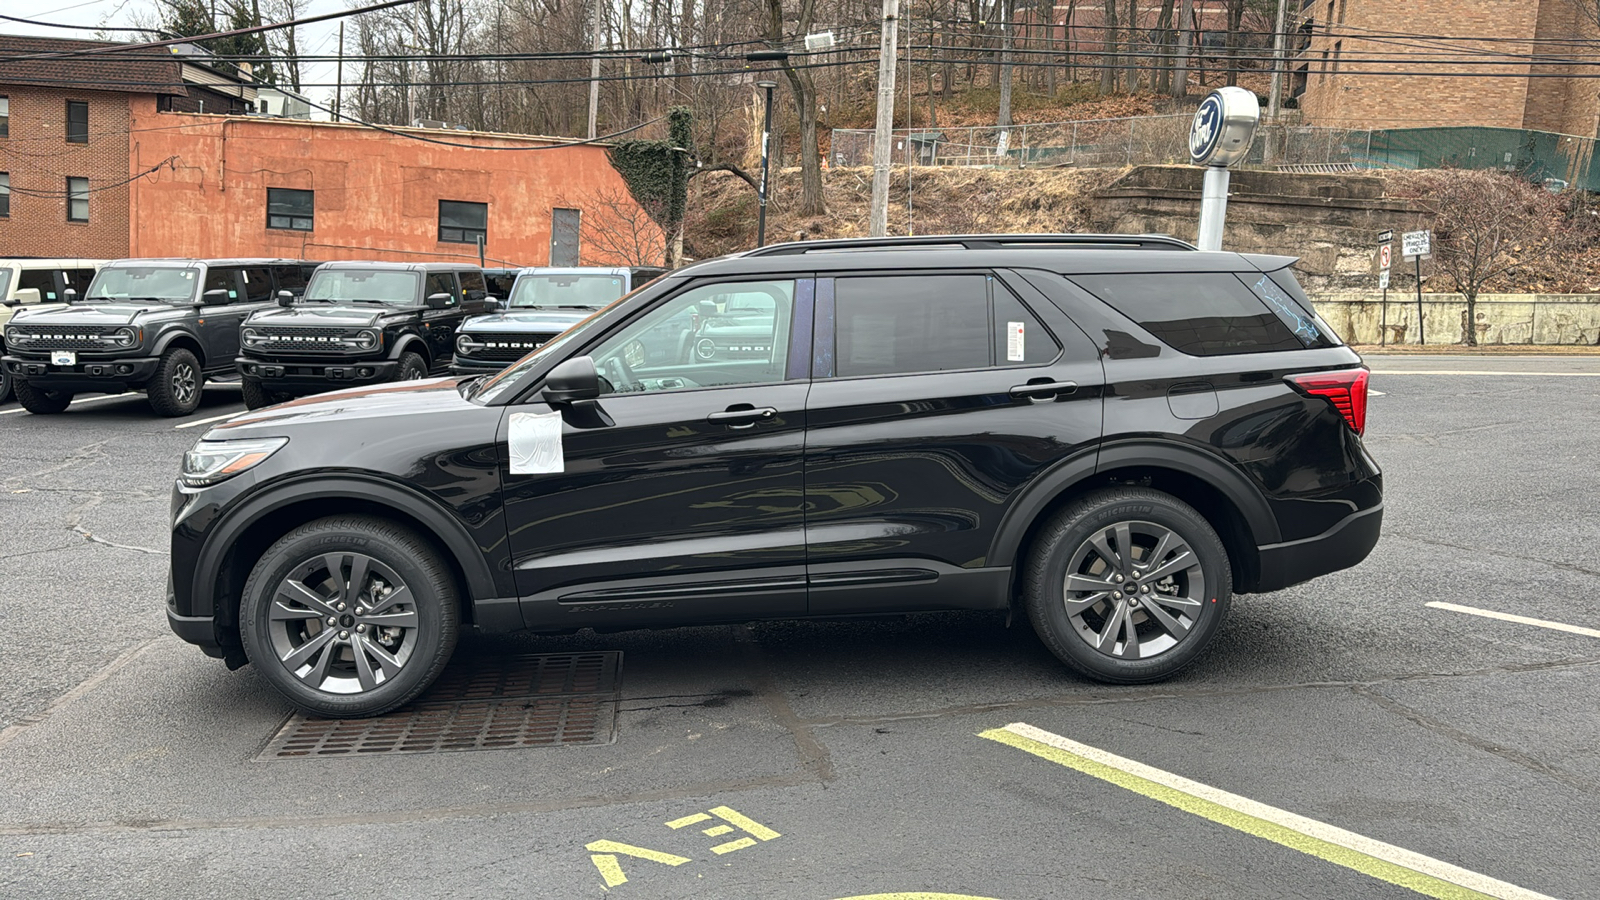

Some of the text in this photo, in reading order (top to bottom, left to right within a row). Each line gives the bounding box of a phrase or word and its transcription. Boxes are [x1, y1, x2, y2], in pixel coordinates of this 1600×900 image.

[1193, 105, 1215, 152] Ford
[1098, 505, 1151, 520] MICHELIN
[584, 805, 781, 888] EV
